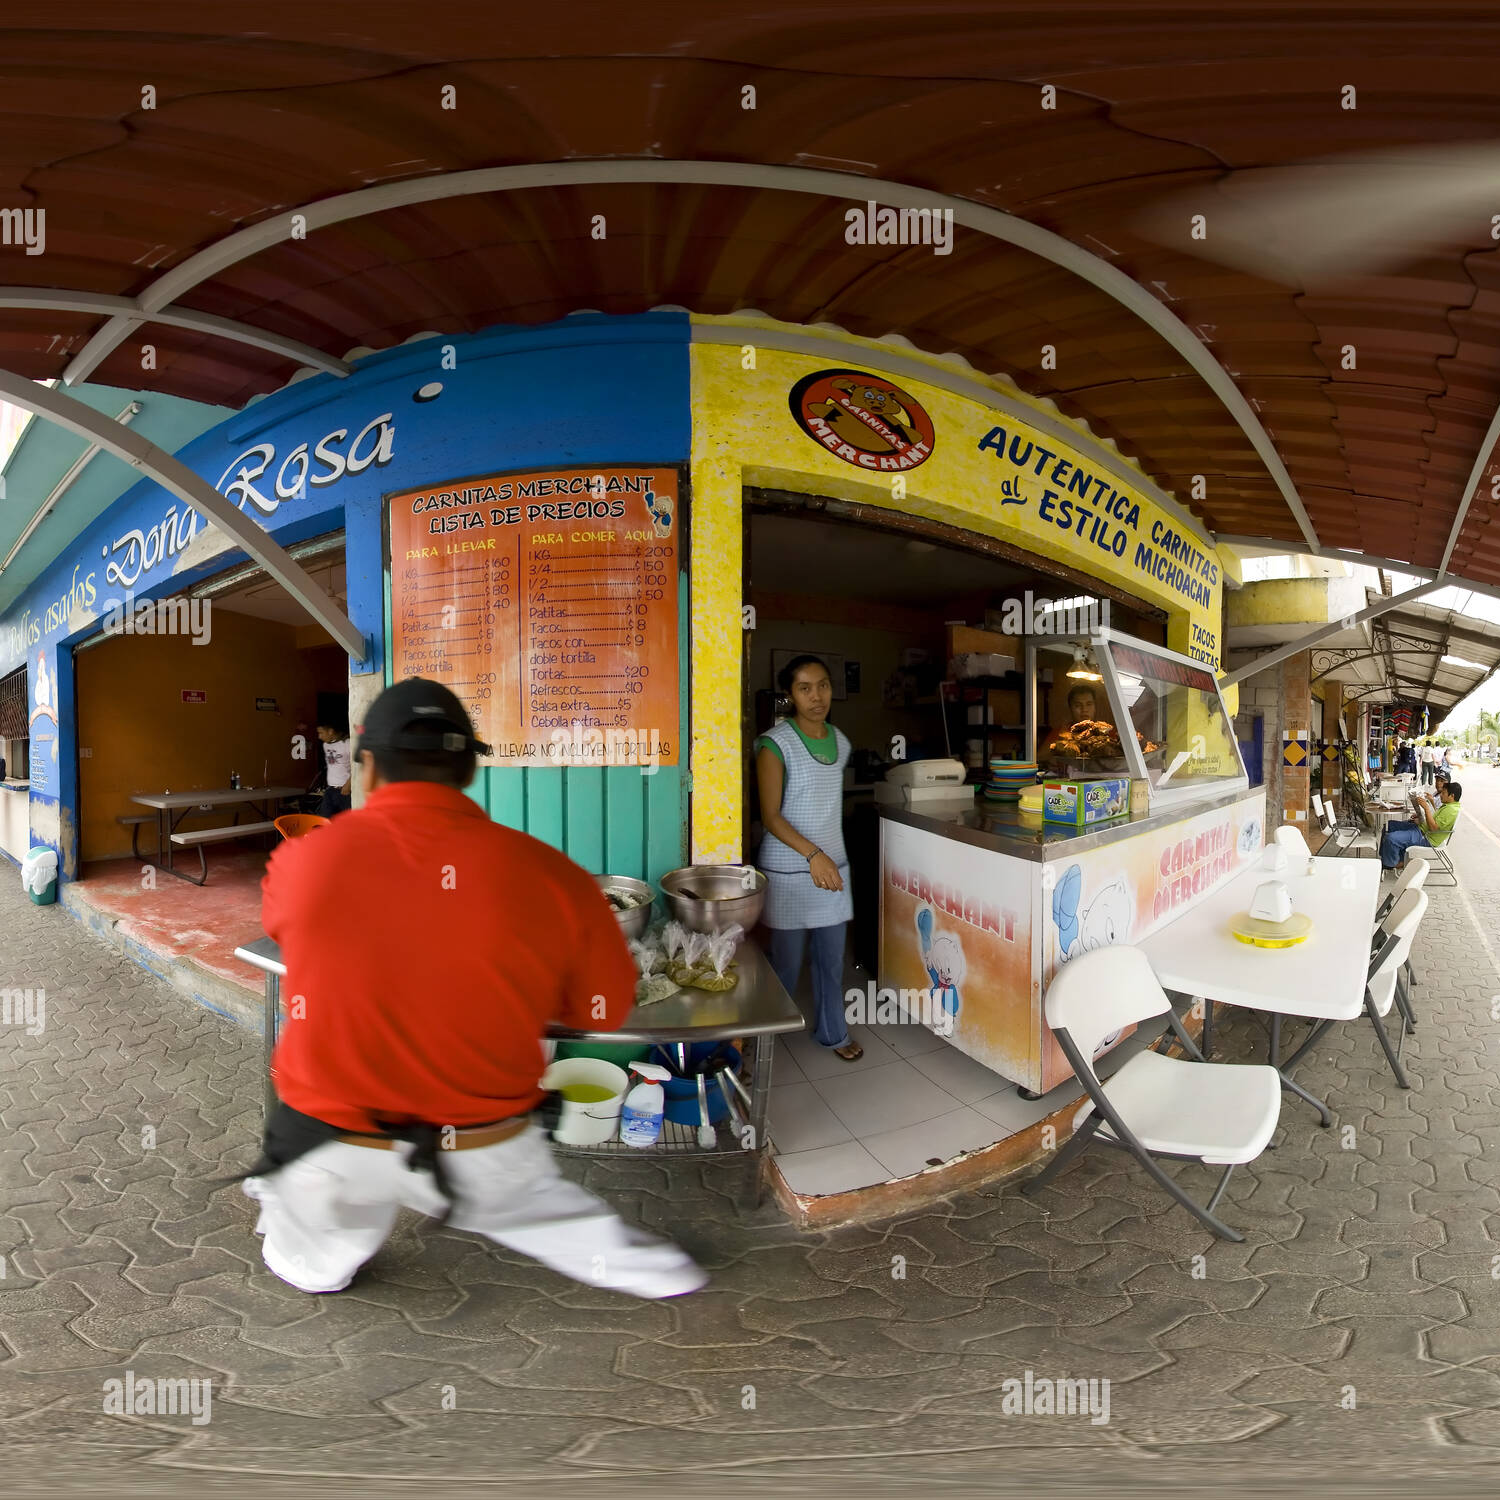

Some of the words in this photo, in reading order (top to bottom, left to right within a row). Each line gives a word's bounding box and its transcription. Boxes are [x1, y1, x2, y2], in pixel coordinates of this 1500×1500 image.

[841, 398, 906, 449] CARNITAS
[808, 418, 930, 469] MERCHANT
[105, 504, 198, 586] Doña
[214, 412, 395, 513] Rosa
[412, 483, 513, 514] CARNITAS
[518, 475, 653, 499] MERCHANT
[978, 426, 1140, 531] AUTENTICA
[1151, 520, 1218, 586] CARNITAS
[429, 511, 485, 534] LISTA
[491, 506, 522, 526] DE
[527, 500, 625, 523] PRECIOS
[532, 533, 564, 545] PARA
[571, 530, 616, 543] COMER
[624, 529, 653, 541] AQUI
[1001, 475, 1020, 497] al
[1038, 489, 1127, 557] ESTILO
[1134, 542, 1211, 609] MICHOACAN
[406, 546, 439, 560] PARA
[447, 538, 496, 554] LLEVAR
[529, 564, 552, 575] 3/4
[44, 564, 96, 635] asados
[529, 606, 567, 618] Patitas
[403, 622, 430, 633] Patitas
[530, 622, 561, 634] Tacos
[403, 636, 425, 647] Tacos
[530, 637, 562, 649] Tacos
[564, 638, 586, 649] con
[1192, 623, 1215, 650] TACOS
[403, 650, 427, 661] Tacos
[428, 650, 445, 660] con
[530, 652, 558, 665] doble
[561, 651, 596, 664] tortilla
[1190, 645, 1219, 672] TORTAS
[403, 663, 424, 675] doble
[426, 660, 453, 672] tortilla
[530, 668, 566, 680] Tortas
[624, 665, 649, 678] $20
[476, 672, 496, 684] $20
[476, 687, 491, 699] $10
[530, 683, 583, 696] Refrescos
[625, 681, 643, 695] $10
[531, 699, 558, 712] Salsa
[560, 698, 590, 711] extra
[617, 697, 631, 711] $5
[531, 714, 568, 728] Cebolla
[570, 714, 600, 727] extra
[614, 713, 628, 727] $5
[500, 743, 536, 757] LLEVAR
[541, 743, 556, 757] NO
[1153, 848, 1232, 921] MERCHANT
[891, 865, 1017, 944] MERCHANT
